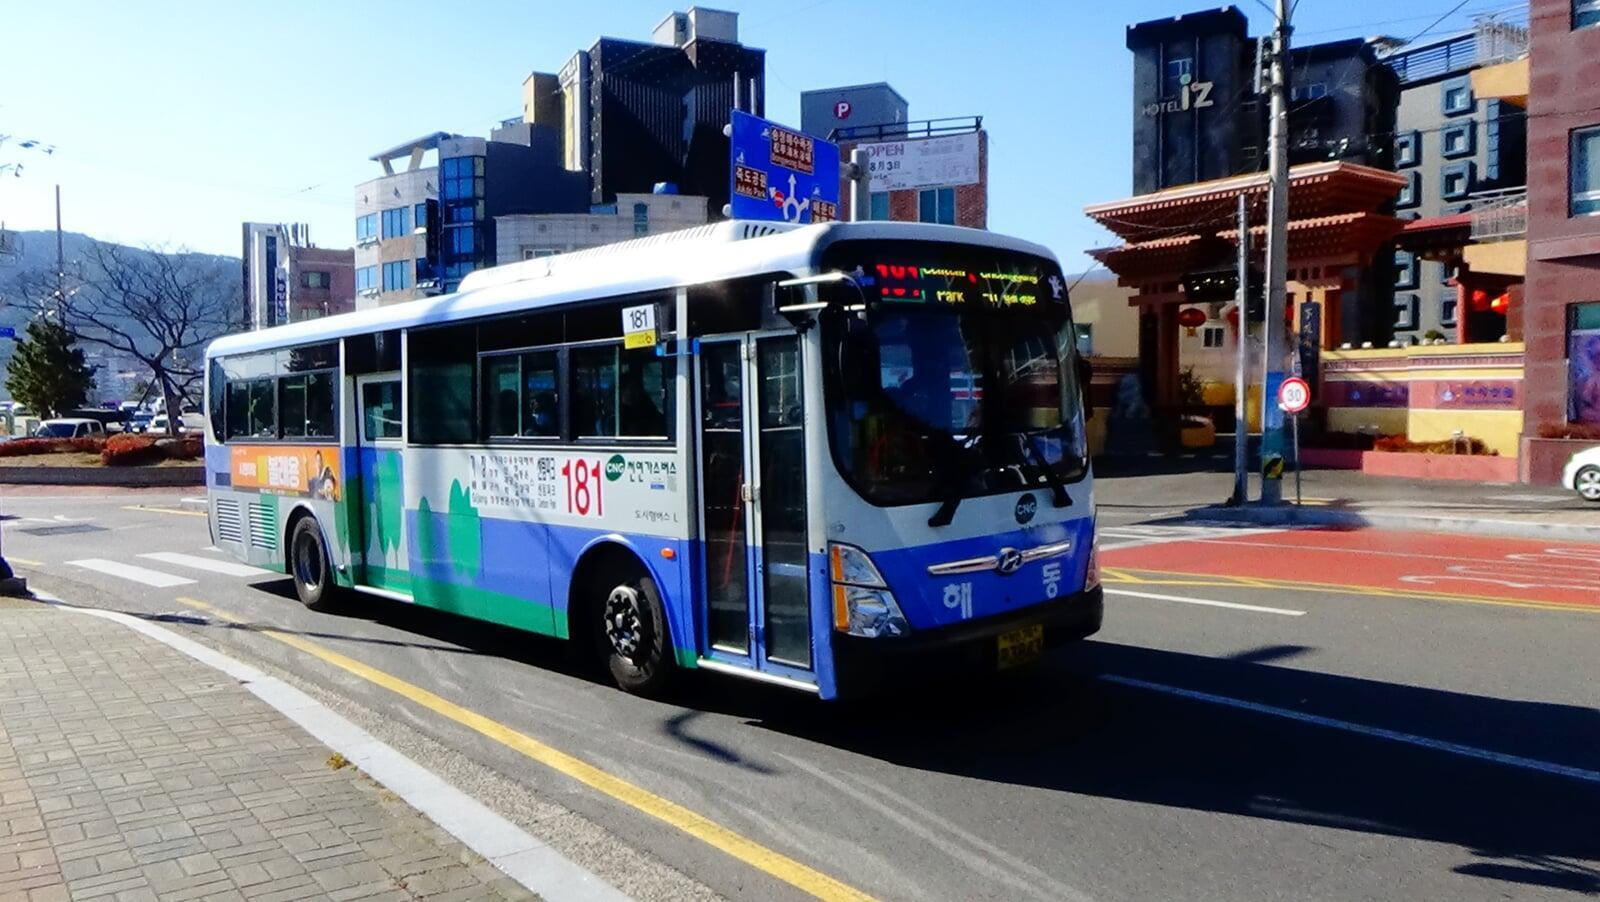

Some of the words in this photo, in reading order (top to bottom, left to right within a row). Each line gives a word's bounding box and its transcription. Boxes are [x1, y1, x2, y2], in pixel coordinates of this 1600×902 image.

[838, 103, 849, 116] P
[1142, 101, 1180, 115] HOTEL
[866, 144, 904, 157] OPEN
[630, 308, 648, 329] 181
[1287, 388, 1302, 402] 30
[606, 462, 625, 474] CNG
[561, 459, 602, 516] 181
[1017, 502, 1037, 515] CNG
[1042, 562, 1061, 598] 동
[943, 582, 973, 619] 해
